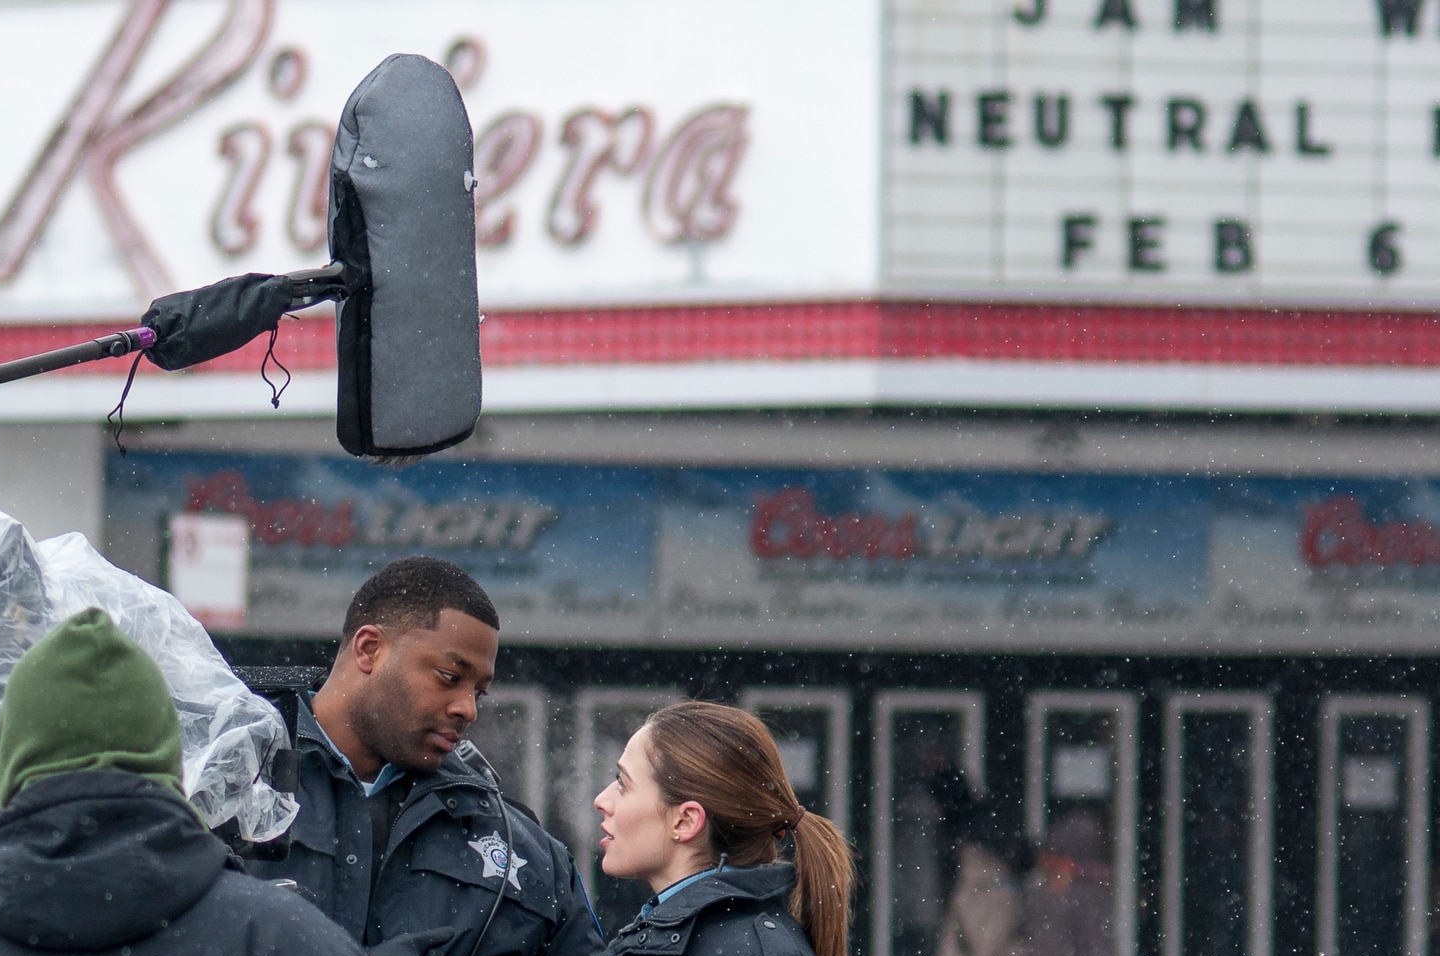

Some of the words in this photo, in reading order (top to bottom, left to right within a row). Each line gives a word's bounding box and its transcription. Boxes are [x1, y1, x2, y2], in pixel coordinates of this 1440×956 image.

[907, 92, 1334, 157] NEUTRAL
[1062, 214, 1256, 275] FEB
[1368, 221, 1403, 276] 6
